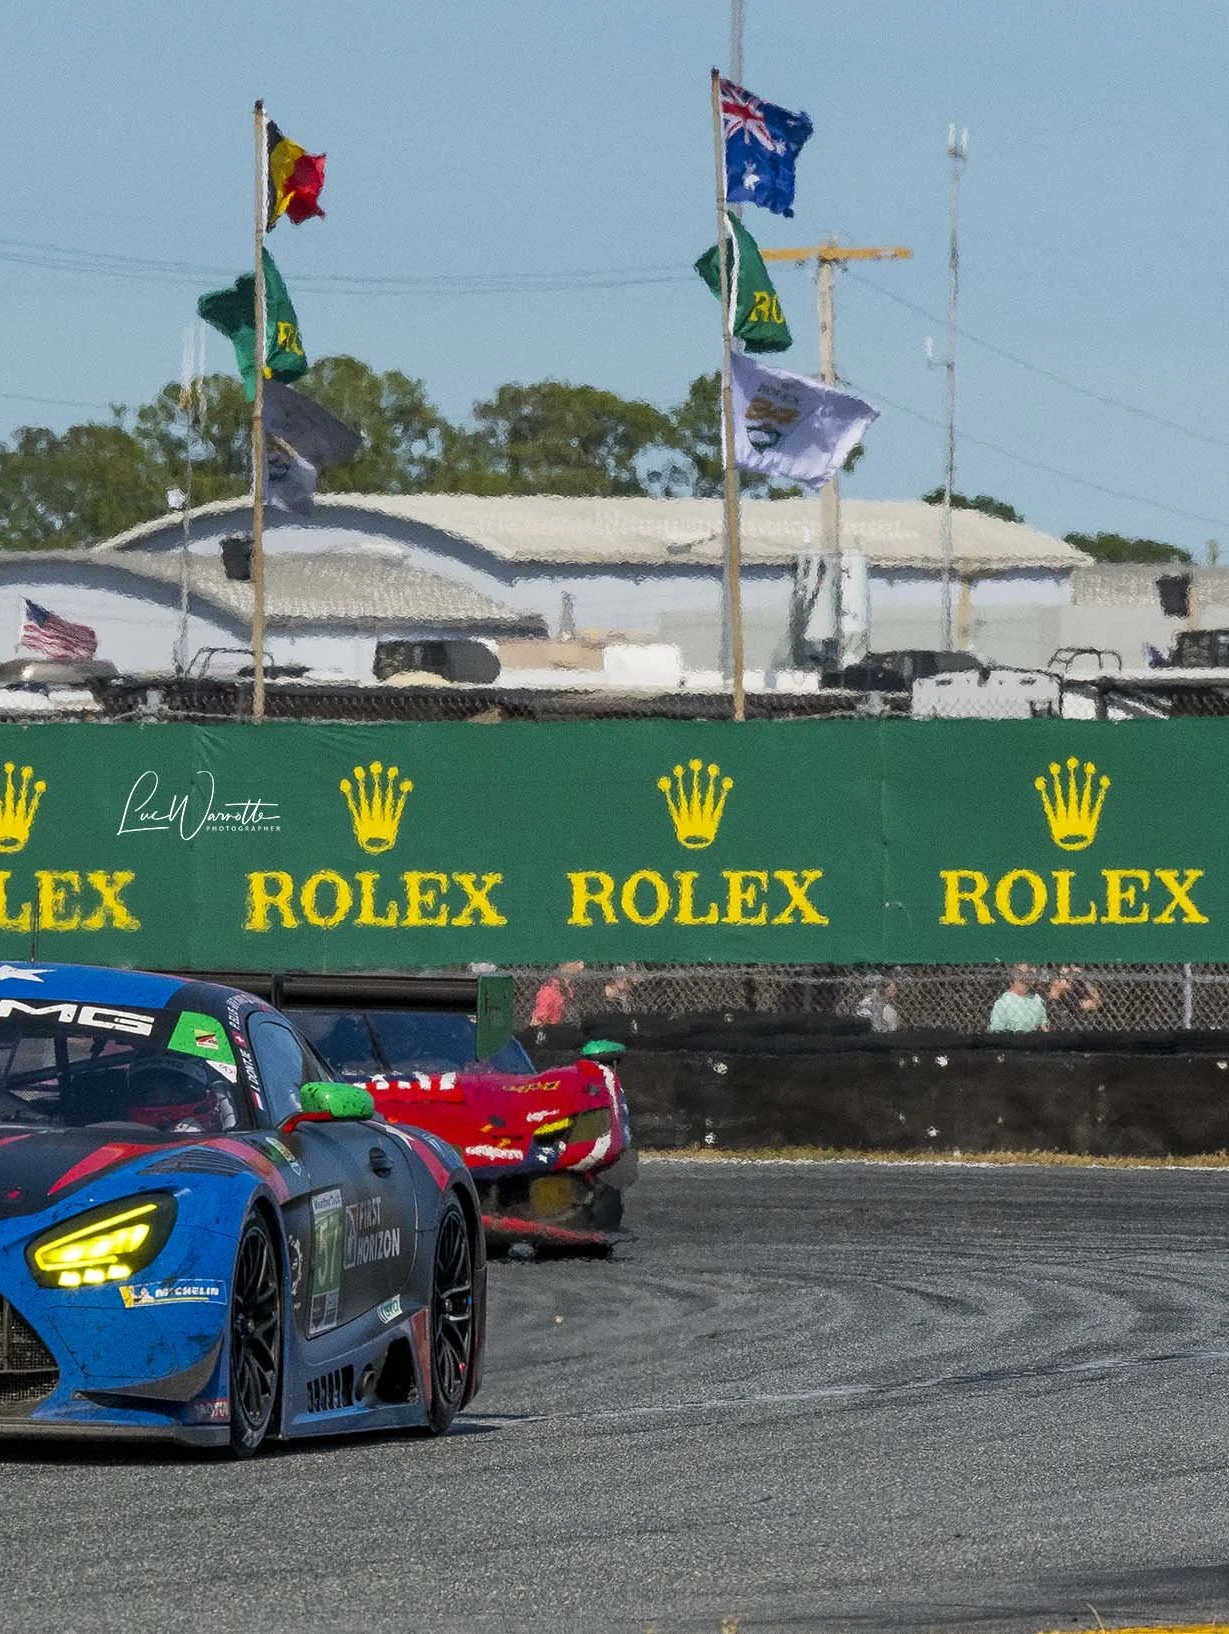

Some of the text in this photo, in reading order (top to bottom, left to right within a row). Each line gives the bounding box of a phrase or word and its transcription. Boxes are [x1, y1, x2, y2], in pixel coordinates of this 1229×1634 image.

[245, 869, 507, 932] ROLEX
[567, 869, 829, 927] ROLEX
[939, 869, 1209, 927] ROLEX
[358, 1196, 381, 1231] FIRST
[357, 1227, 400, 1265] HORIZON
